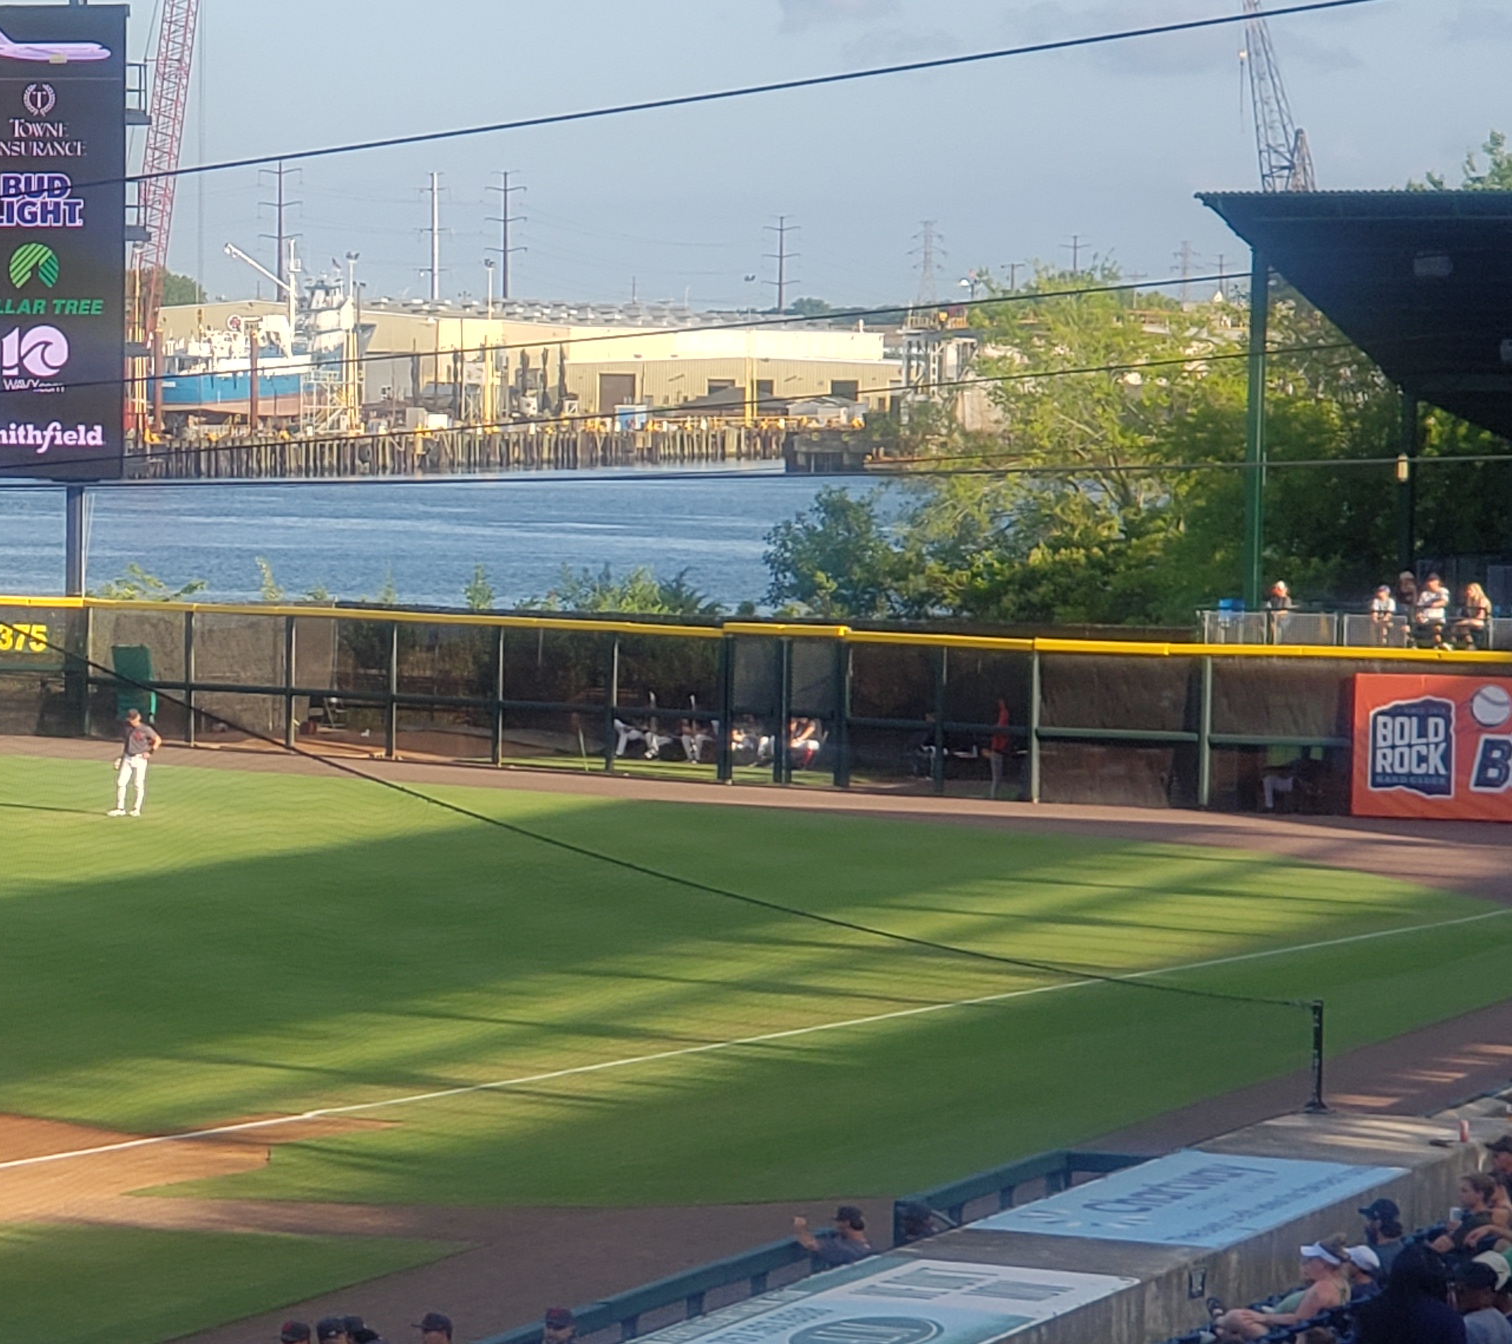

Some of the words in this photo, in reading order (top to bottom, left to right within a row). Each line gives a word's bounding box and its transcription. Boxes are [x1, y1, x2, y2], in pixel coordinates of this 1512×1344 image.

[9, 119, 68, 138] TOWNE
[0, 173, 72, 199] BUD
[52, 299, 104, 314] TREE
[1376, 715, 1445, 748] BOLD
[1376, 742, 1448, 774] ROCK
